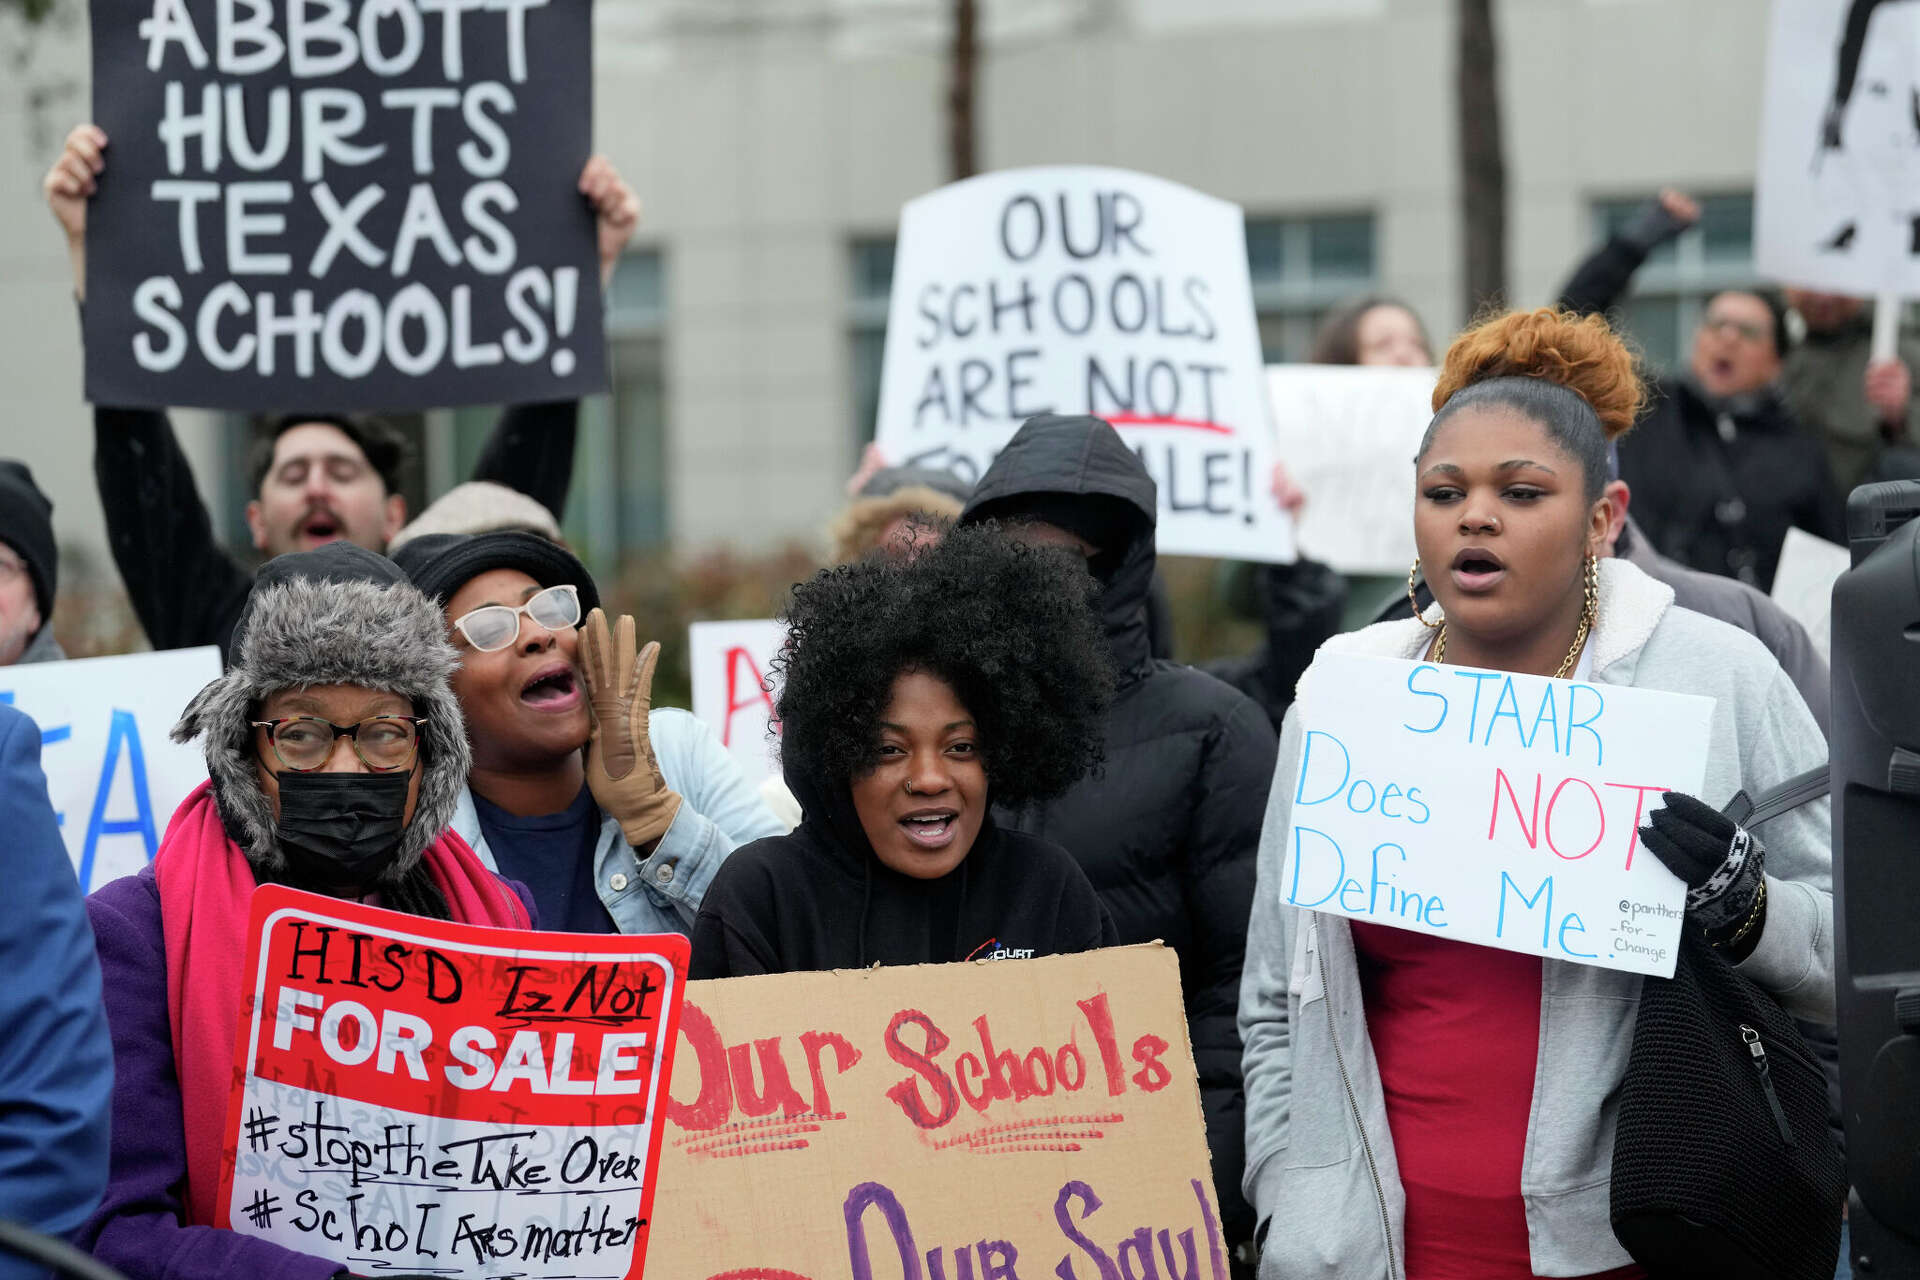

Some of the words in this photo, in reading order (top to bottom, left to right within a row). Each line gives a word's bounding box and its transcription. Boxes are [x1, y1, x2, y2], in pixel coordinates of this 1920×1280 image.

[139, 0, 549, 82] ABBOTT
[158, 82, 516, 182] HURTS
[151, 181, 518, 277] TEXAS
[1000, 190, 1154, 263] OUR
[133, 267, 579, 378] SCHOOLS!
[915, 272, 1217, 350] SCHOOLS
[914, 348, 1057, 430] ARE
[1087, 357, 1229, 427] NOT
[1138, 444, 1256, 526] LE!
[1403, 665, 1605, 766] STAAR
[1295, 730, 1431, 824] Does
[1488, 767, 1672, 871] NOT
[1287, 826, 1449, 929] Define
[287, 921, 463, 1004] HISD
[562, 962, 657, 1018] Not
[1614, 937, 1667, 963] Change
[272, 985, 436, 1083] FOR
[444, 1025, 647, 1096] SALE
[886, 991, 1173, 1130] Schools
